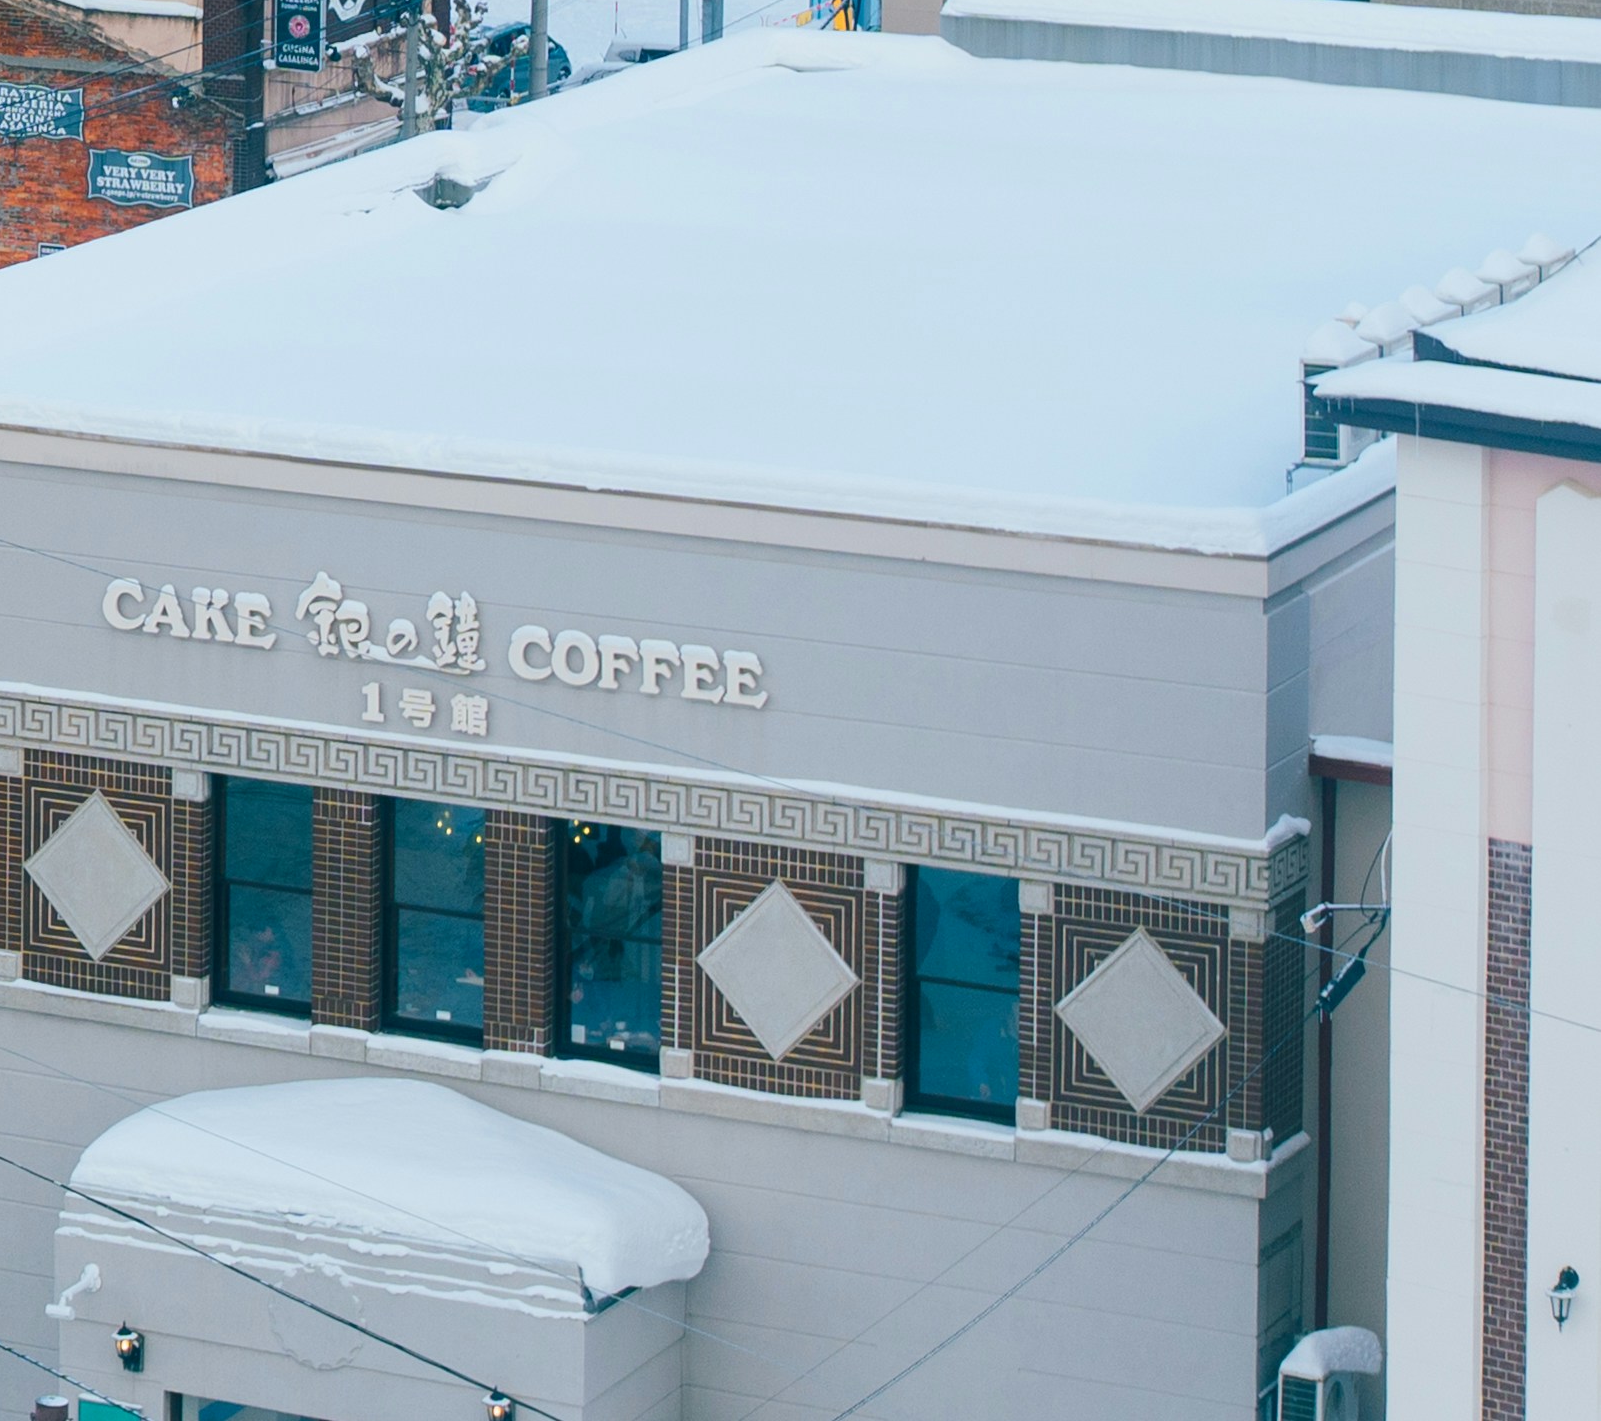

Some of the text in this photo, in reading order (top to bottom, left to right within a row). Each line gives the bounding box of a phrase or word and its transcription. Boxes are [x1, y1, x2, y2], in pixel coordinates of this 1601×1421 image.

[96, 176, 185, 194] STRAWBERRY
[103, 165, 176, 182] VERY VERY
[102, 571, 769, 710] CAKE 銀の鐘 COFFEE
[361, 681, 489, 737] 1号館
